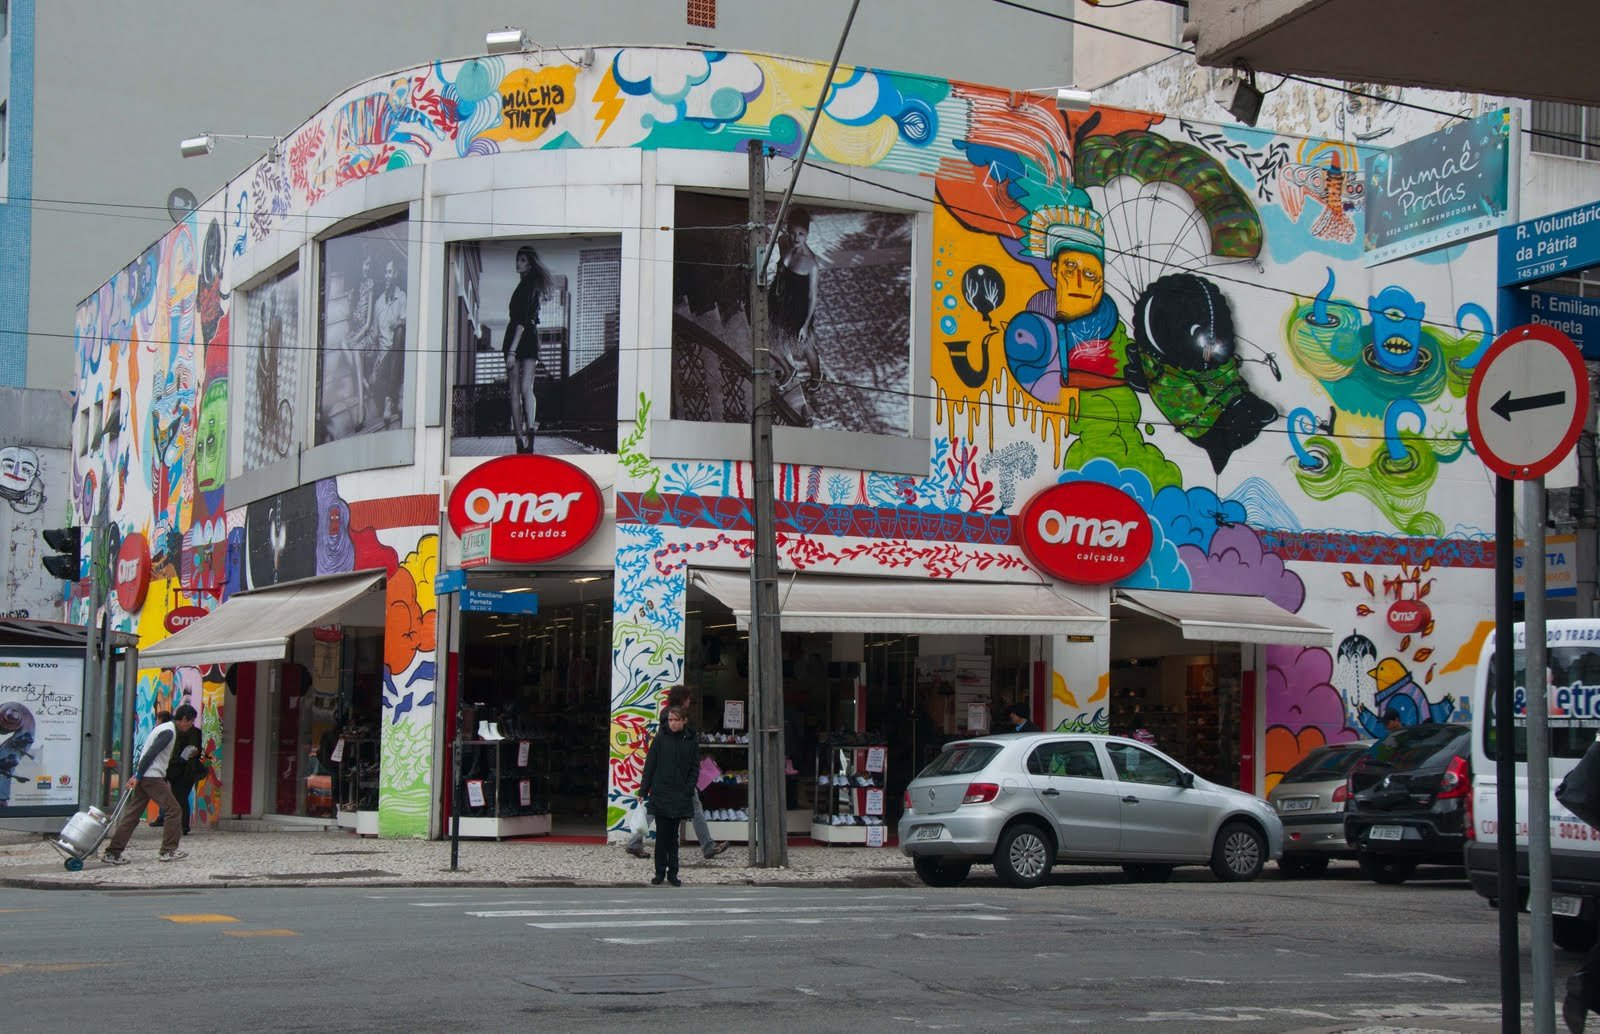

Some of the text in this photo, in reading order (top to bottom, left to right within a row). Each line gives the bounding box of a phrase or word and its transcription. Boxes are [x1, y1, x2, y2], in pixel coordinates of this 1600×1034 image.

[504, 107, 557, 129] TINTA
[1387, 140, 1479, 197] Lumaê
[1398, 181, 1466, 216] Pratas
[1404, 221, 1419, 230] UMA
[1422, 203, 1477, 224] REVENDEDORA
[1516, 224, 1530, 240] R.
[1516, 235, 1577, 262] da Pátria
[1517, 262, 1555, 279] 145 a 310
[1531, 294, 1545, 310] R.
[510, 528, 567, 540] calçados
[1038, 509, 1139, 548] Omar
[1076, 552, 1125, 563] calçados
[171, 615, 201, 626] Oma
